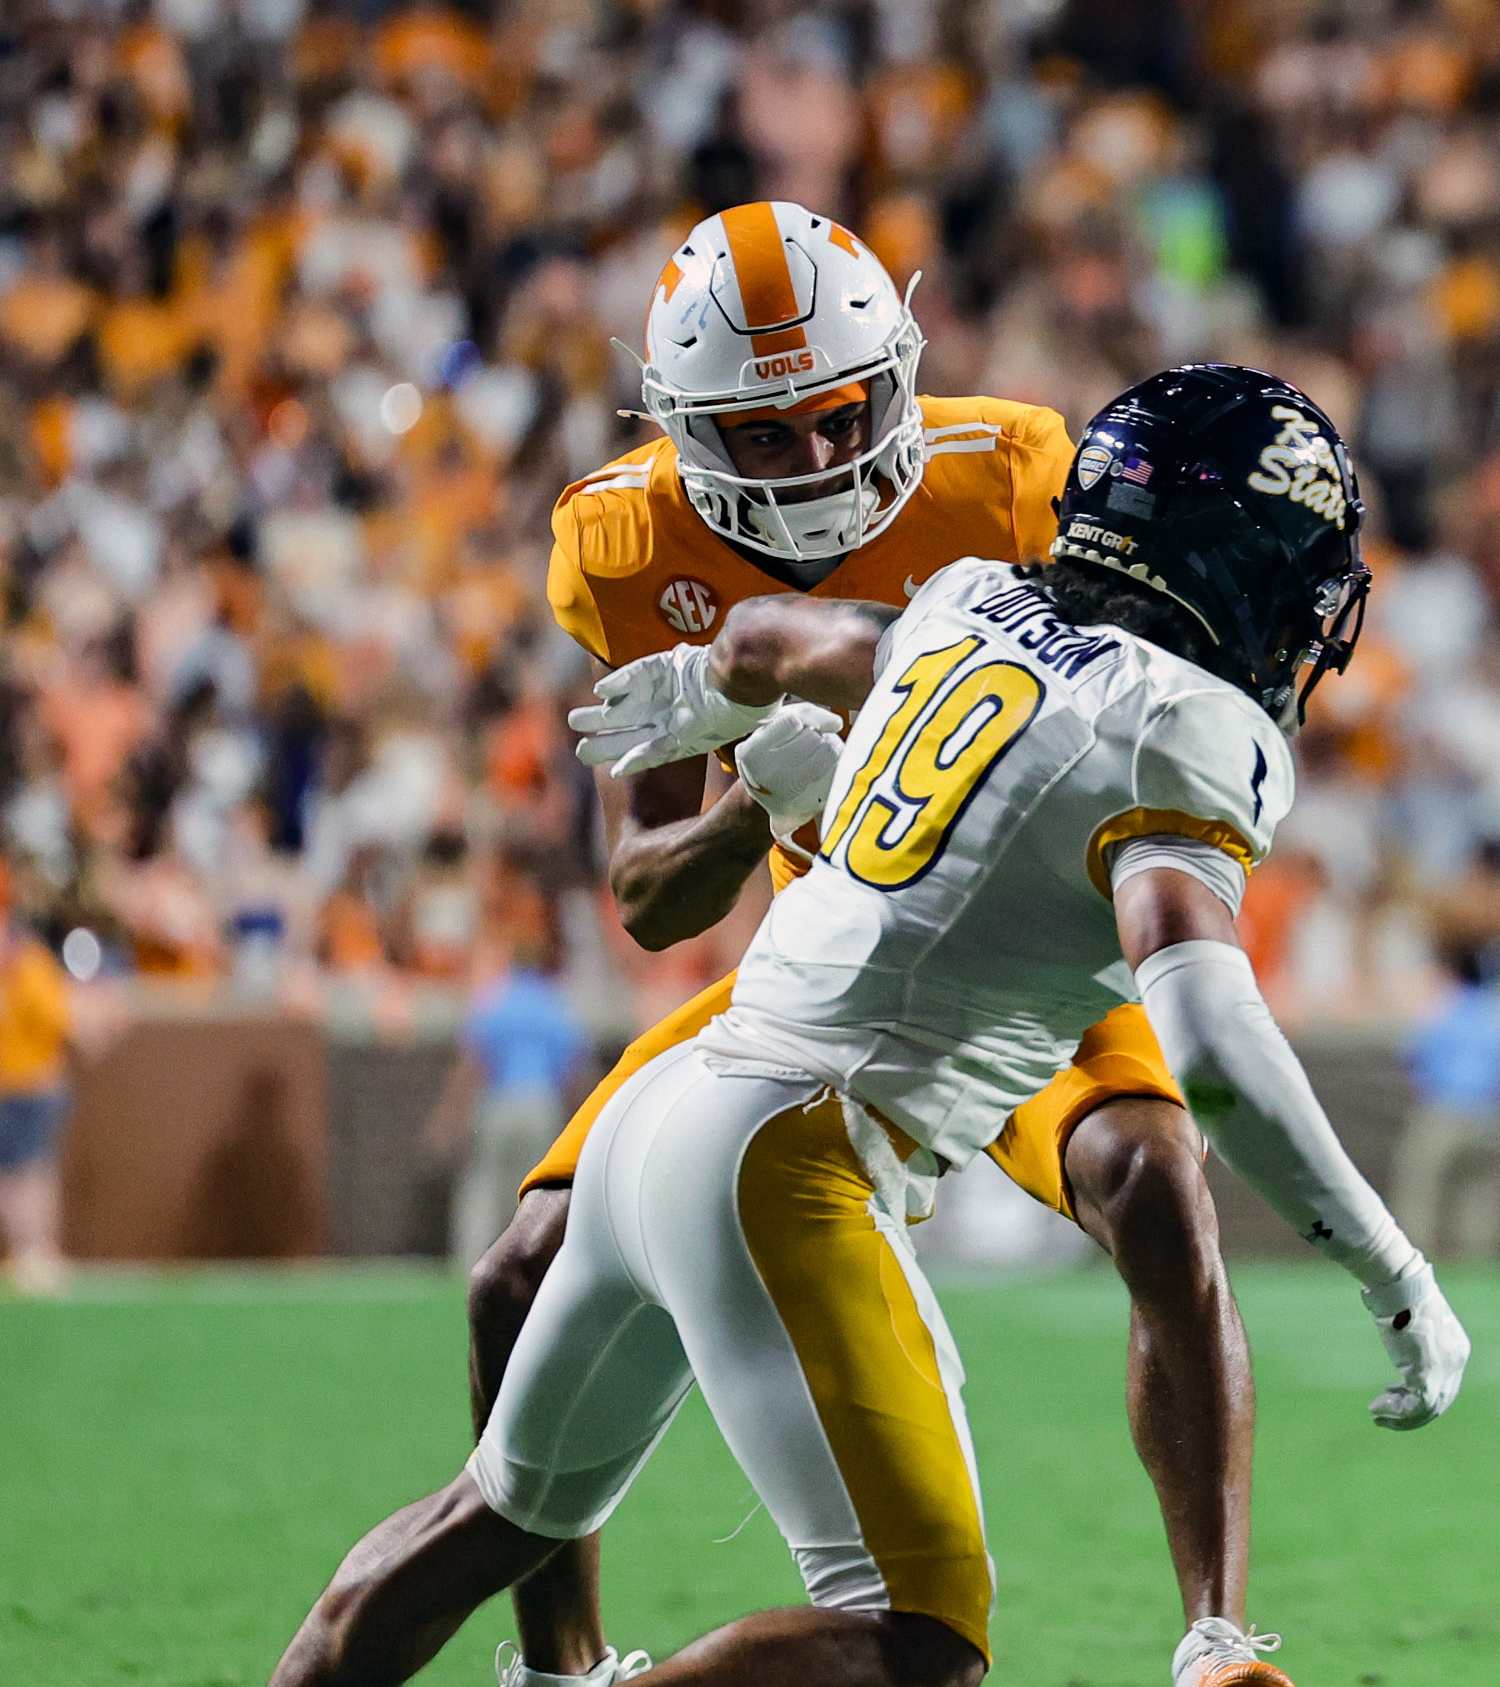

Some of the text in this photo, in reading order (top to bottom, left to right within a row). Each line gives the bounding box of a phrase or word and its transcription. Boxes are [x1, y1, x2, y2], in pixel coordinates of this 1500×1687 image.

[754, 351, 815, 380] VOLS
[1066, 521, 1105, 543] KENT
[658, 579, 718, 633] SEC
[816, 634, 1047, 893] 19
